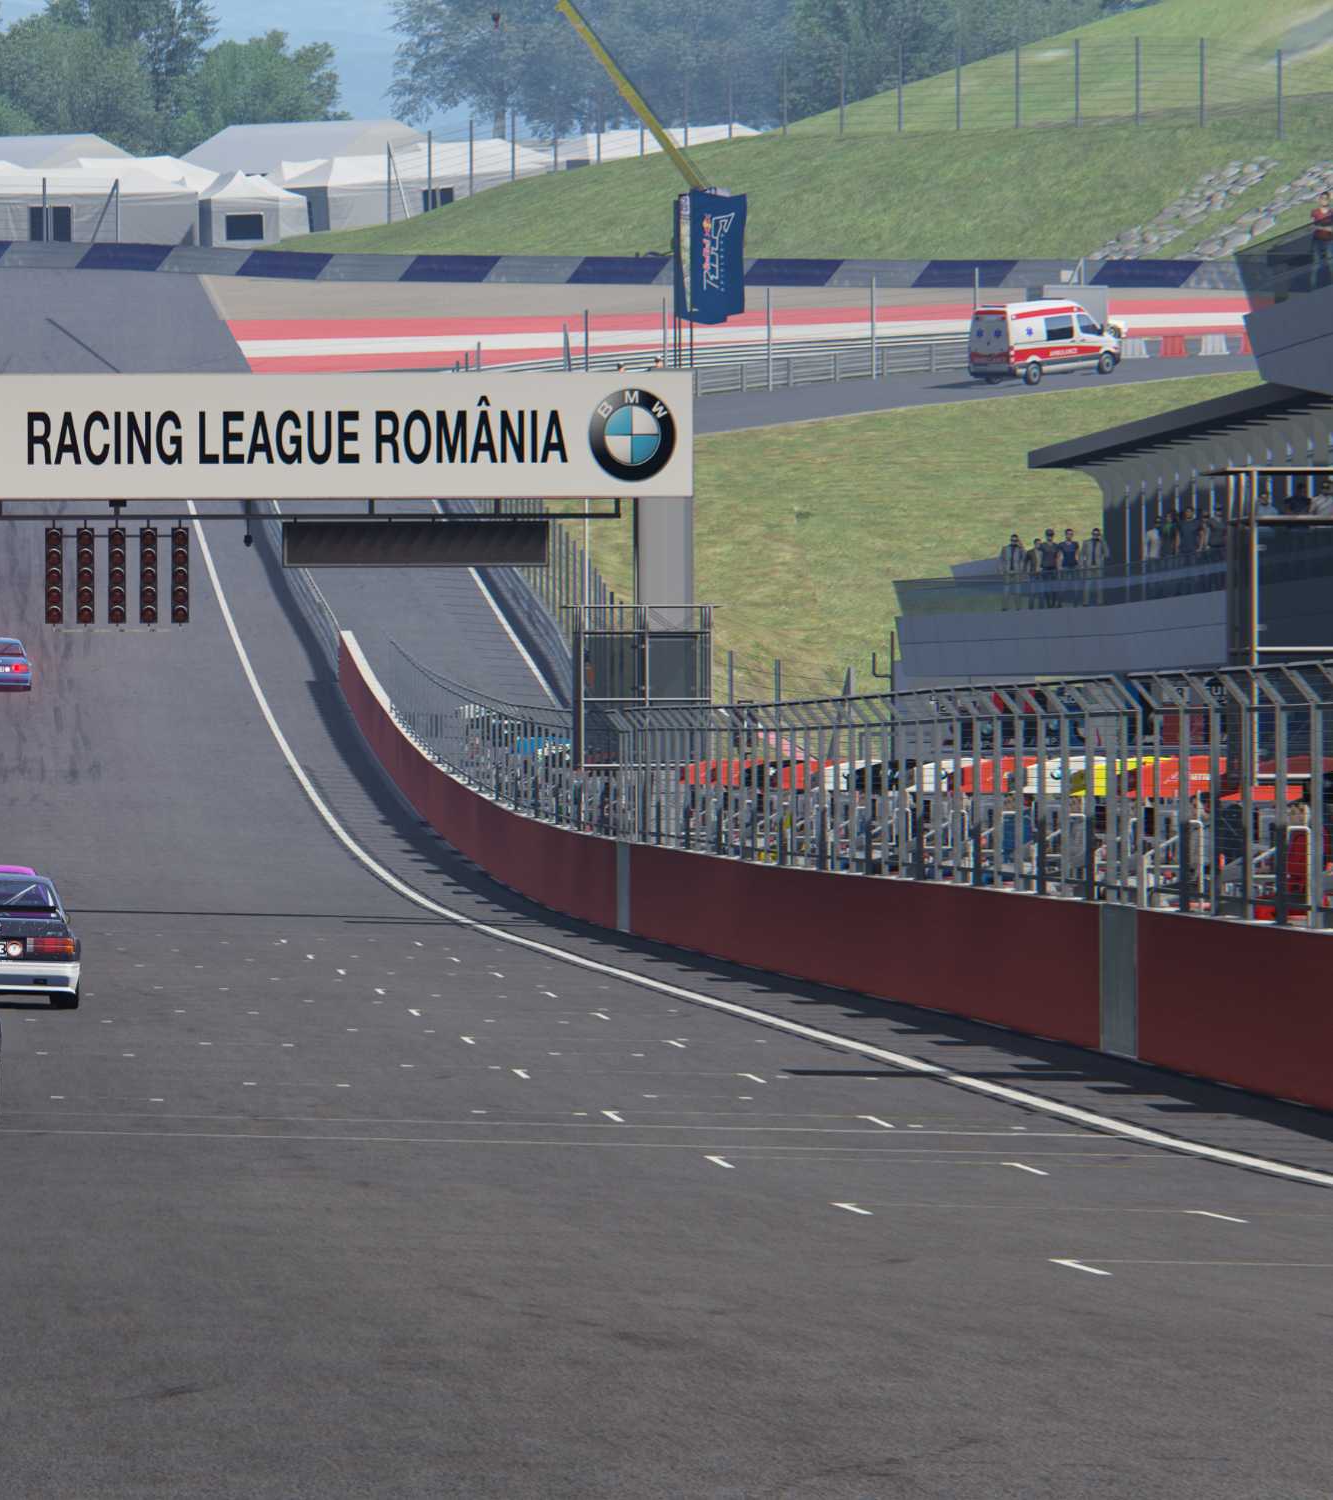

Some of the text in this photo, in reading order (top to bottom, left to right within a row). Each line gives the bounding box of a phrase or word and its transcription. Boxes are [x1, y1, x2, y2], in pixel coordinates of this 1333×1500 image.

[597, 390, 668, 419] BMW
[28, 396, 569, 465] RACING LEAGUE ROMÂNIA
